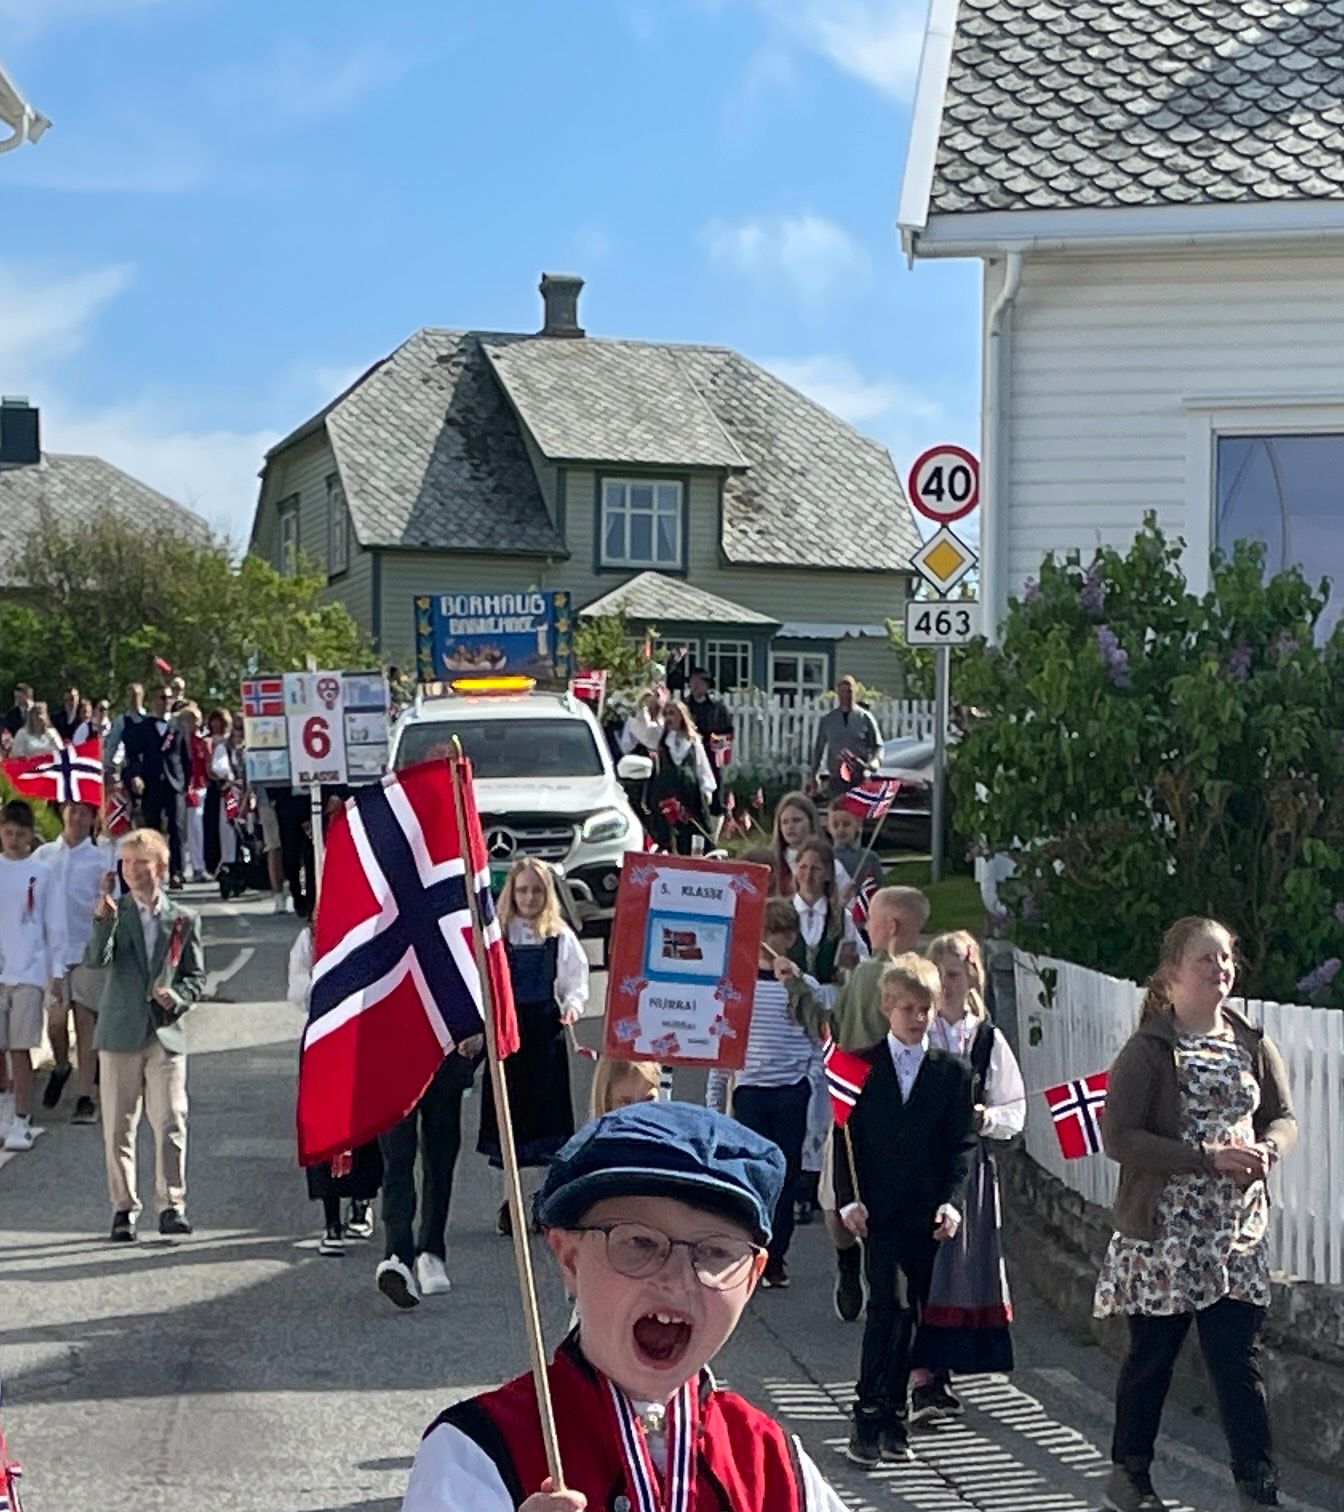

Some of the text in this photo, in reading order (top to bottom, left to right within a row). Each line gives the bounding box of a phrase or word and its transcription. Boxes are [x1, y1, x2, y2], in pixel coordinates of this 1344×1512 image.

[921, 465, 972, 502] 40
[440, 594, 546, 616] BORHAUG
[915, 611, 970, 636] 463
[302, 716, 331, 759] 6
